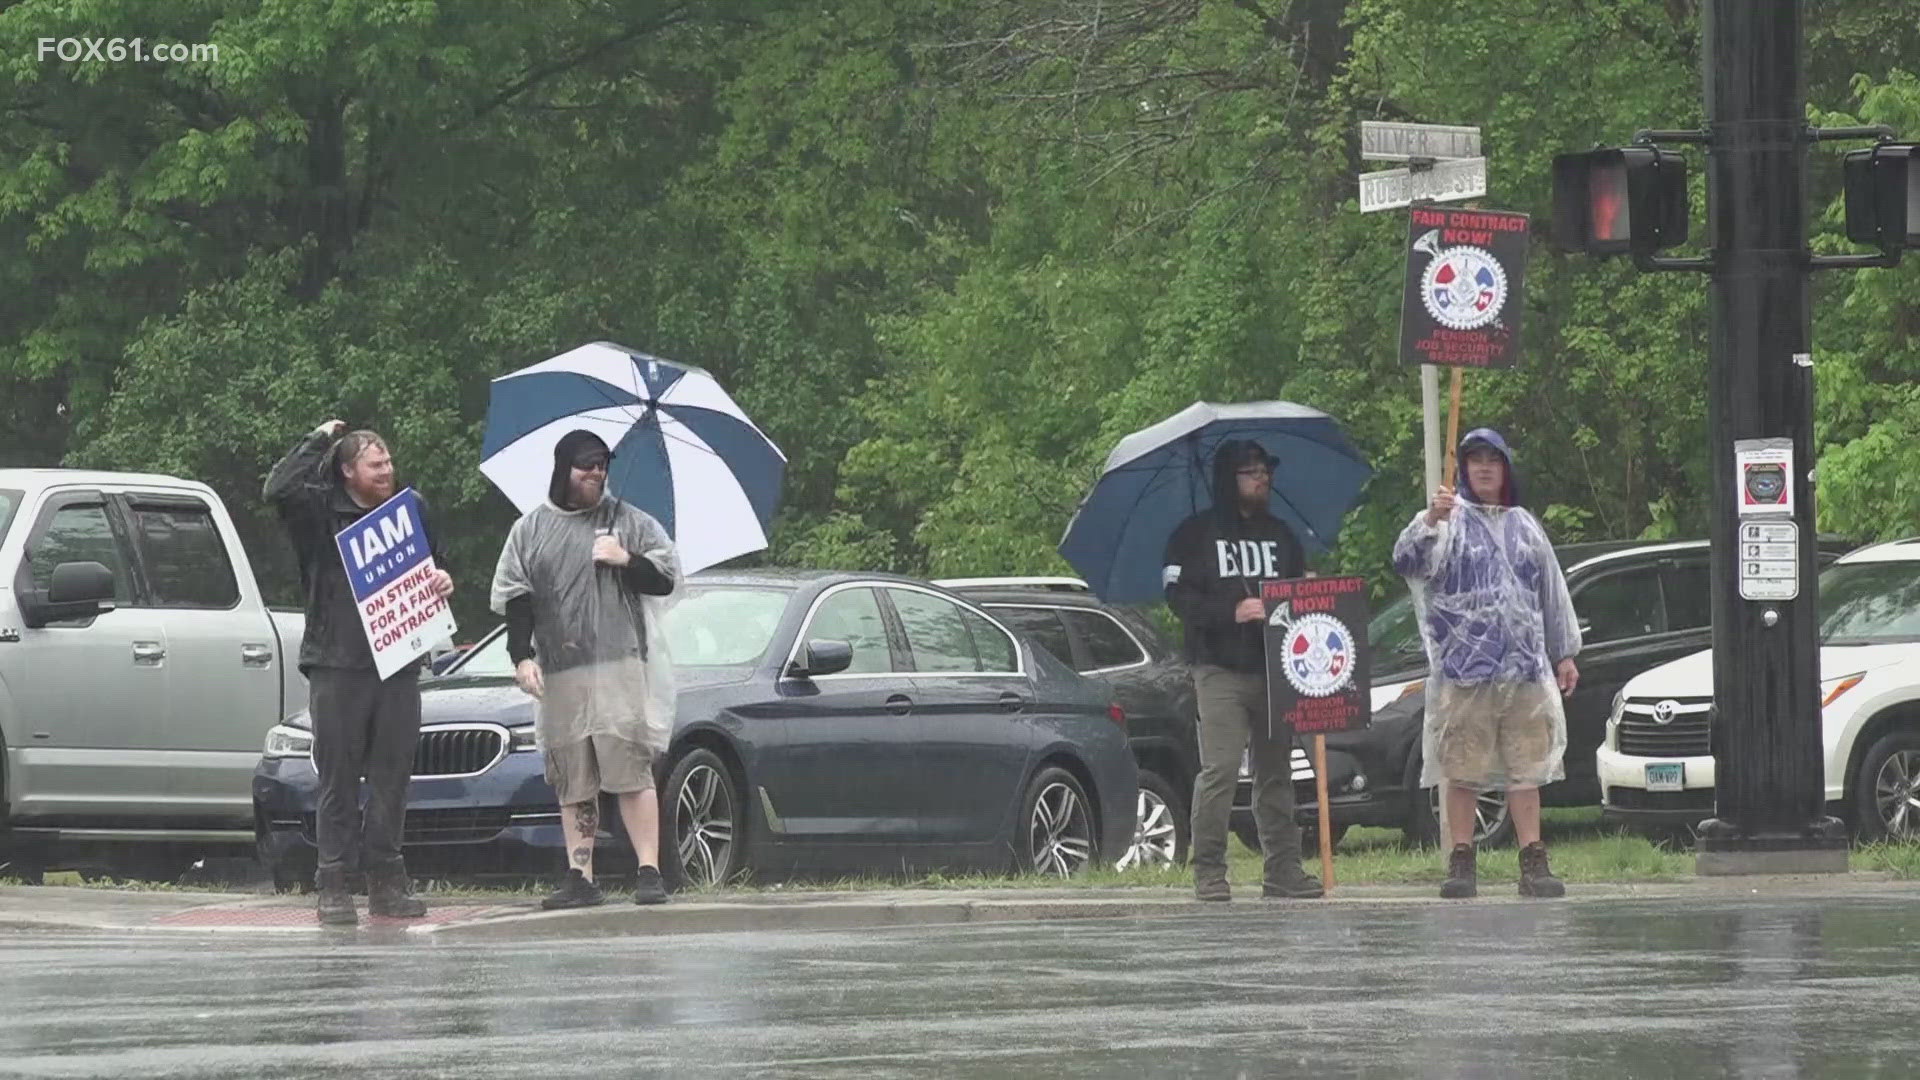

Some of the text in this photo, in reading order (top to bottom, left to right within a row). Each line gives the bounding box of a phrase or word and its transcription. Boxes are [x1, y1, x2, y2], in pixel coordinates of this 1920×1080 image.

[1364, 127, 1428, 155] SILVER
[1412, 211, 1527, 232] FAIR CONTRACT
[1443, 229, 1493, 245] NOW!
[1415, 339, 1504, 355] JOB SECURITY
[349, 504, 414, 570] IAM
[365, 544, 416, 584] UNION
[1216, 539, 1279, 578] BDE
[366, 565, 434, 616] ON STRIKE
[1263, 579, 1363, 598] FAIR CONTRACT
[369, 611, 396, 635] FOR
[399, 602, 408, 618] A
[1292, 597, 1335, 612] NOW!
[373, 596, 447, 652] CONTRACT!
[1306, 705, 1360, 720] SECURITY
